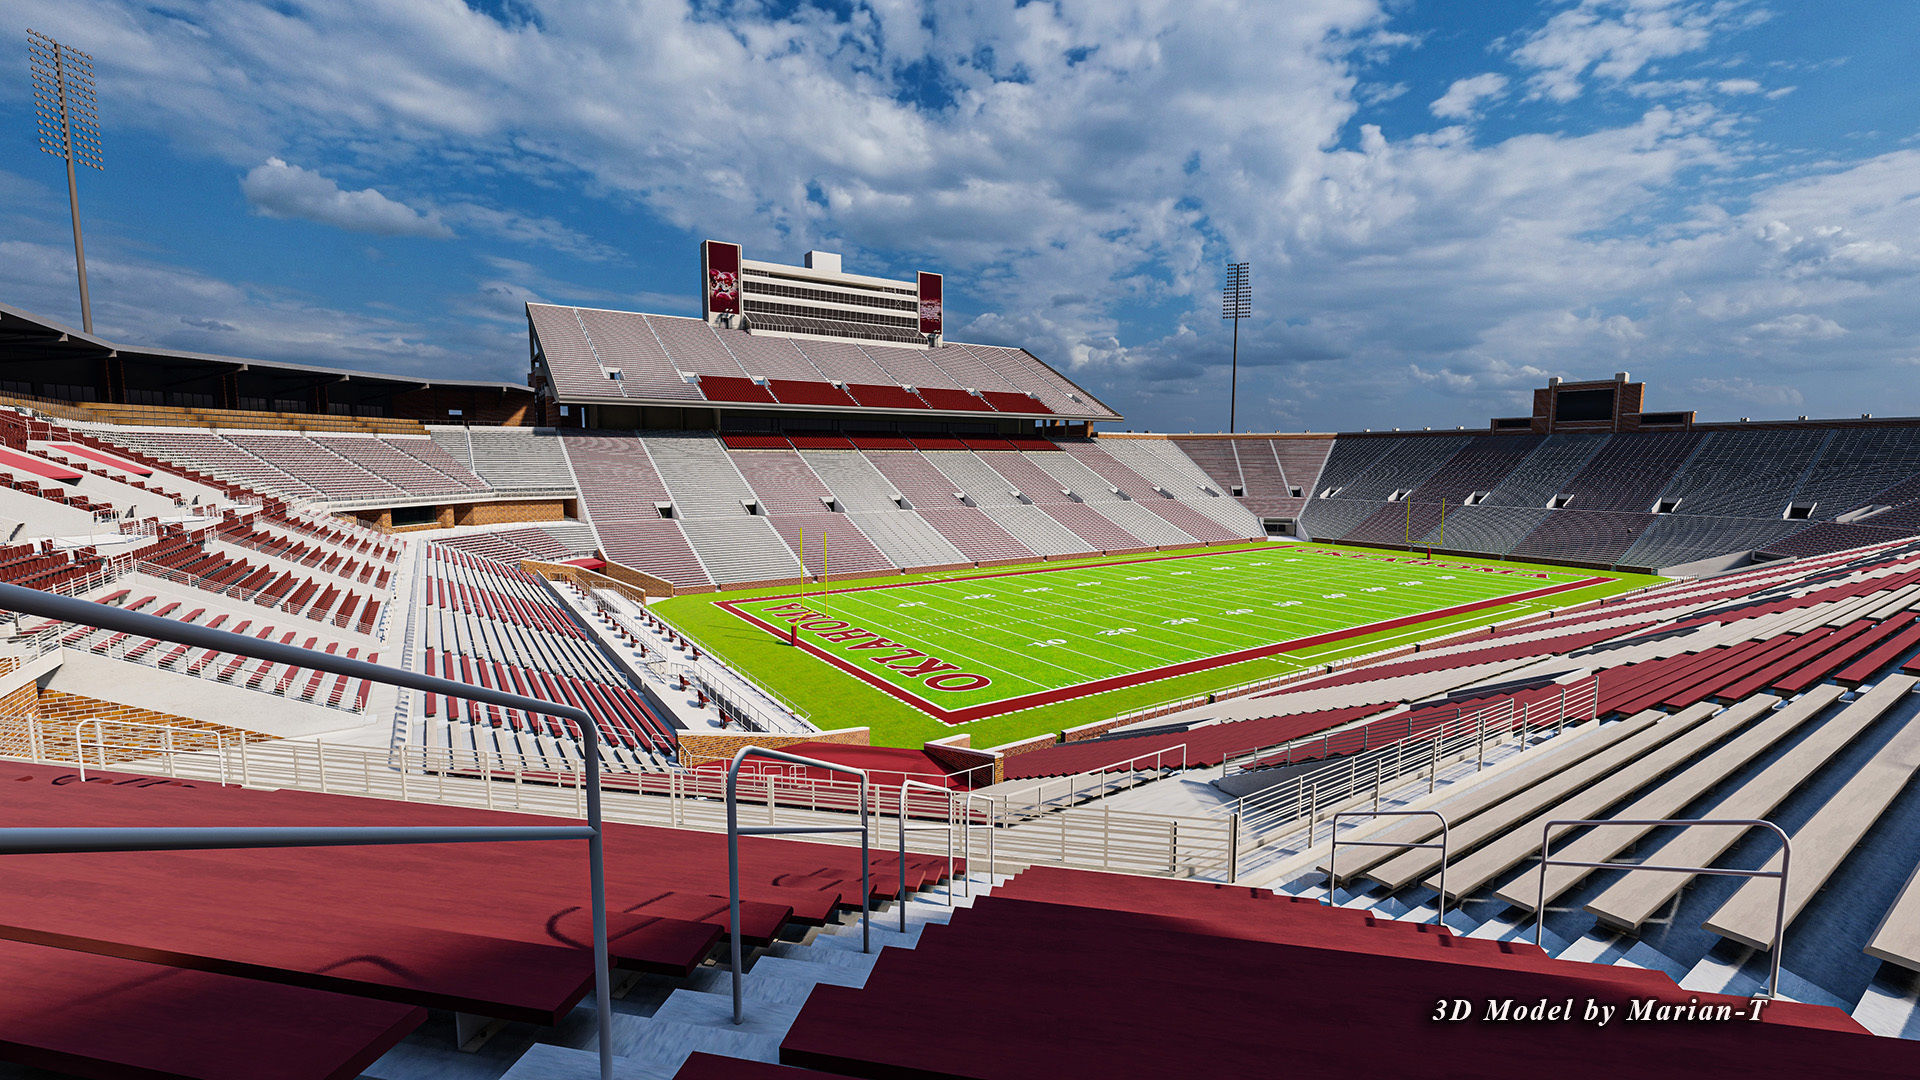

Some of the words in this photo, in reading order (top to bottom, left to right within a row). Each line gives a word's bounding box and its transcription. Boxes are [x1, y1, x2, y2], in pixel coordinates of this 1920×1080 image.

[1102, 627, 1138, 637] 20
[761, 602, 992, 692] OKLAHOMA
[1032, 638, 1068, 648] 10
